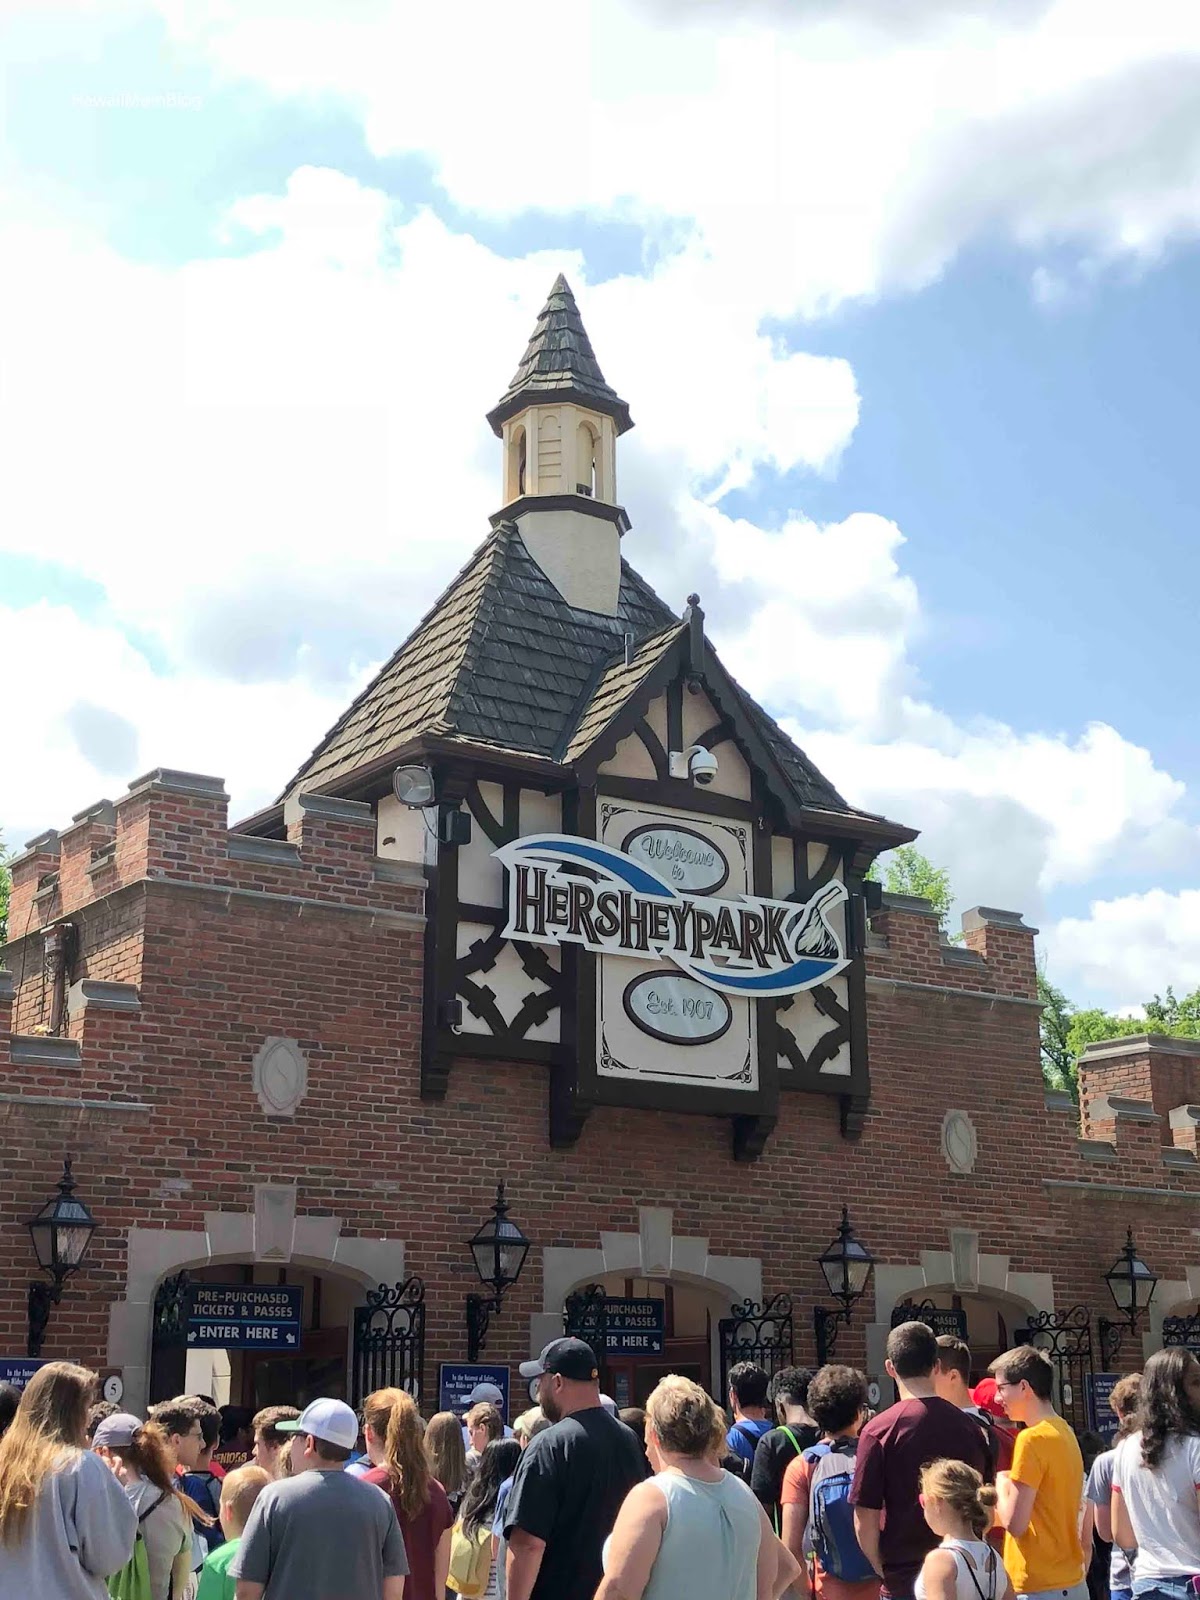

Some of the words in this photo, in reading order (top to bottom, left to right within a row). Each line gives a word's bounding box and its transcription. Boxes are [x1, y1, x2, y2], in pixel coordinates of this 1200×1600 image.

[641, 835, 715, 867] Welcome
[672, 864, 685, 880] to
[514, 864, 794, 969] HERSHEYPARK
[646, 991, 678, 1016] Est.
[682, 998, 714, 1020] 1907
[198, 1291, 289, 1304] PRE-PURCHASED
[193, 1304, 235, 1315] TICKETS
[241, 1306, 248, 1316] &
[254, 1306, 293, 1317] PASSES
[614, 1316, 622, 1327] &
[625, 1316, 657, 1327] PASSES
[199, 1326, 240, 1338] ENTER
[246, 1327, 278, 1339] HERE
[622, 1336, 649, 1347] HERE
[110, 1383, 117, 1396] 5
[871, 1388, 877, 1398] 9
